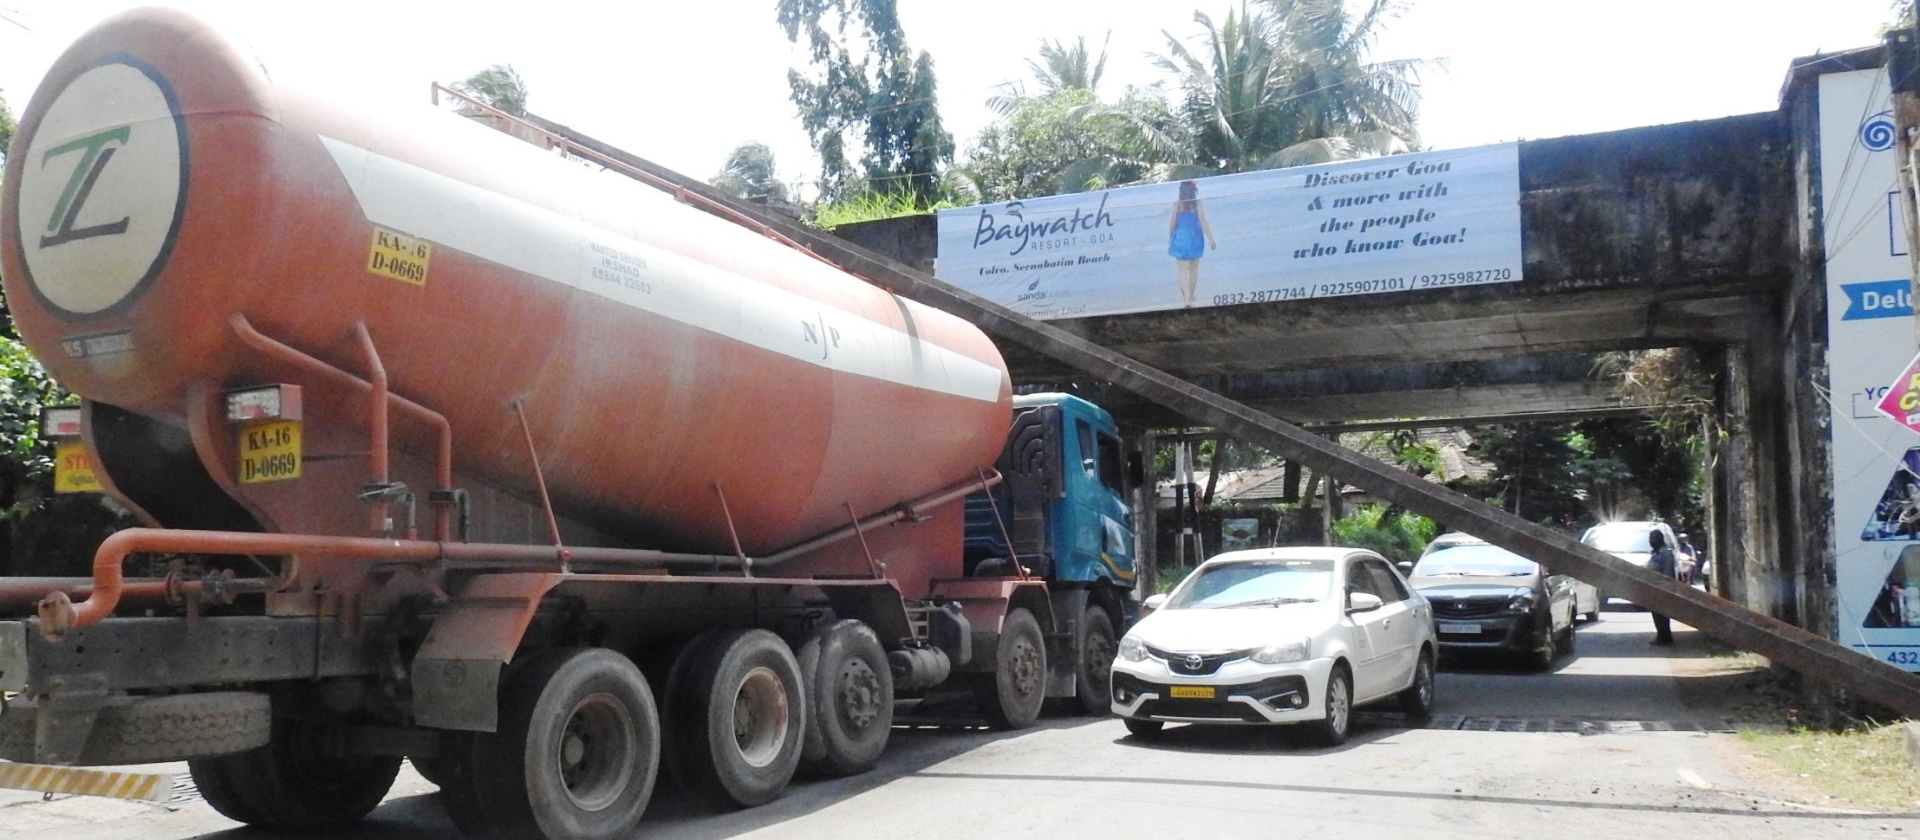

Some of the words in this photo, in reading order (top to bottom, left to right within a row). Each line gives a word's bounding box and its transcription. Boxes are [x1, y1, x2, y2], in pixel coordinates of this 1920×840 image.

[1303, 167, 1400, 188] Discover
[1406, 160, 1452, 176] Goa
[1307, 195, 1323, 212] &
[1332, 192, 1391, 209] more
[1398, 181, 1449, 201] with
[973, 191, 1115, 256] Baywatch
[1319, 217, 1354, 233] the
[1359, 208, 1436, 233] people
[1031, 237, 1077, 251] RESORT
[1090, 233, 1115, 245] GOA
[1293, 242, 1337, 259] who
[1344, 238, 1404, 255] know
[1412, 227, 1467, 247] Goa!
[1013, 259, 1074, 272] Sernabatim
[1078, 252, 1111, 265] Beach
[1213, 287, 1306, 306] 0832-2877744
[1310, 284, 1317, 299] /
[1320, 277, 1406, 296] 9225907101
[1410, 274, 1417, 291] /
[1421, 268, 1511, 287] 9225982720
